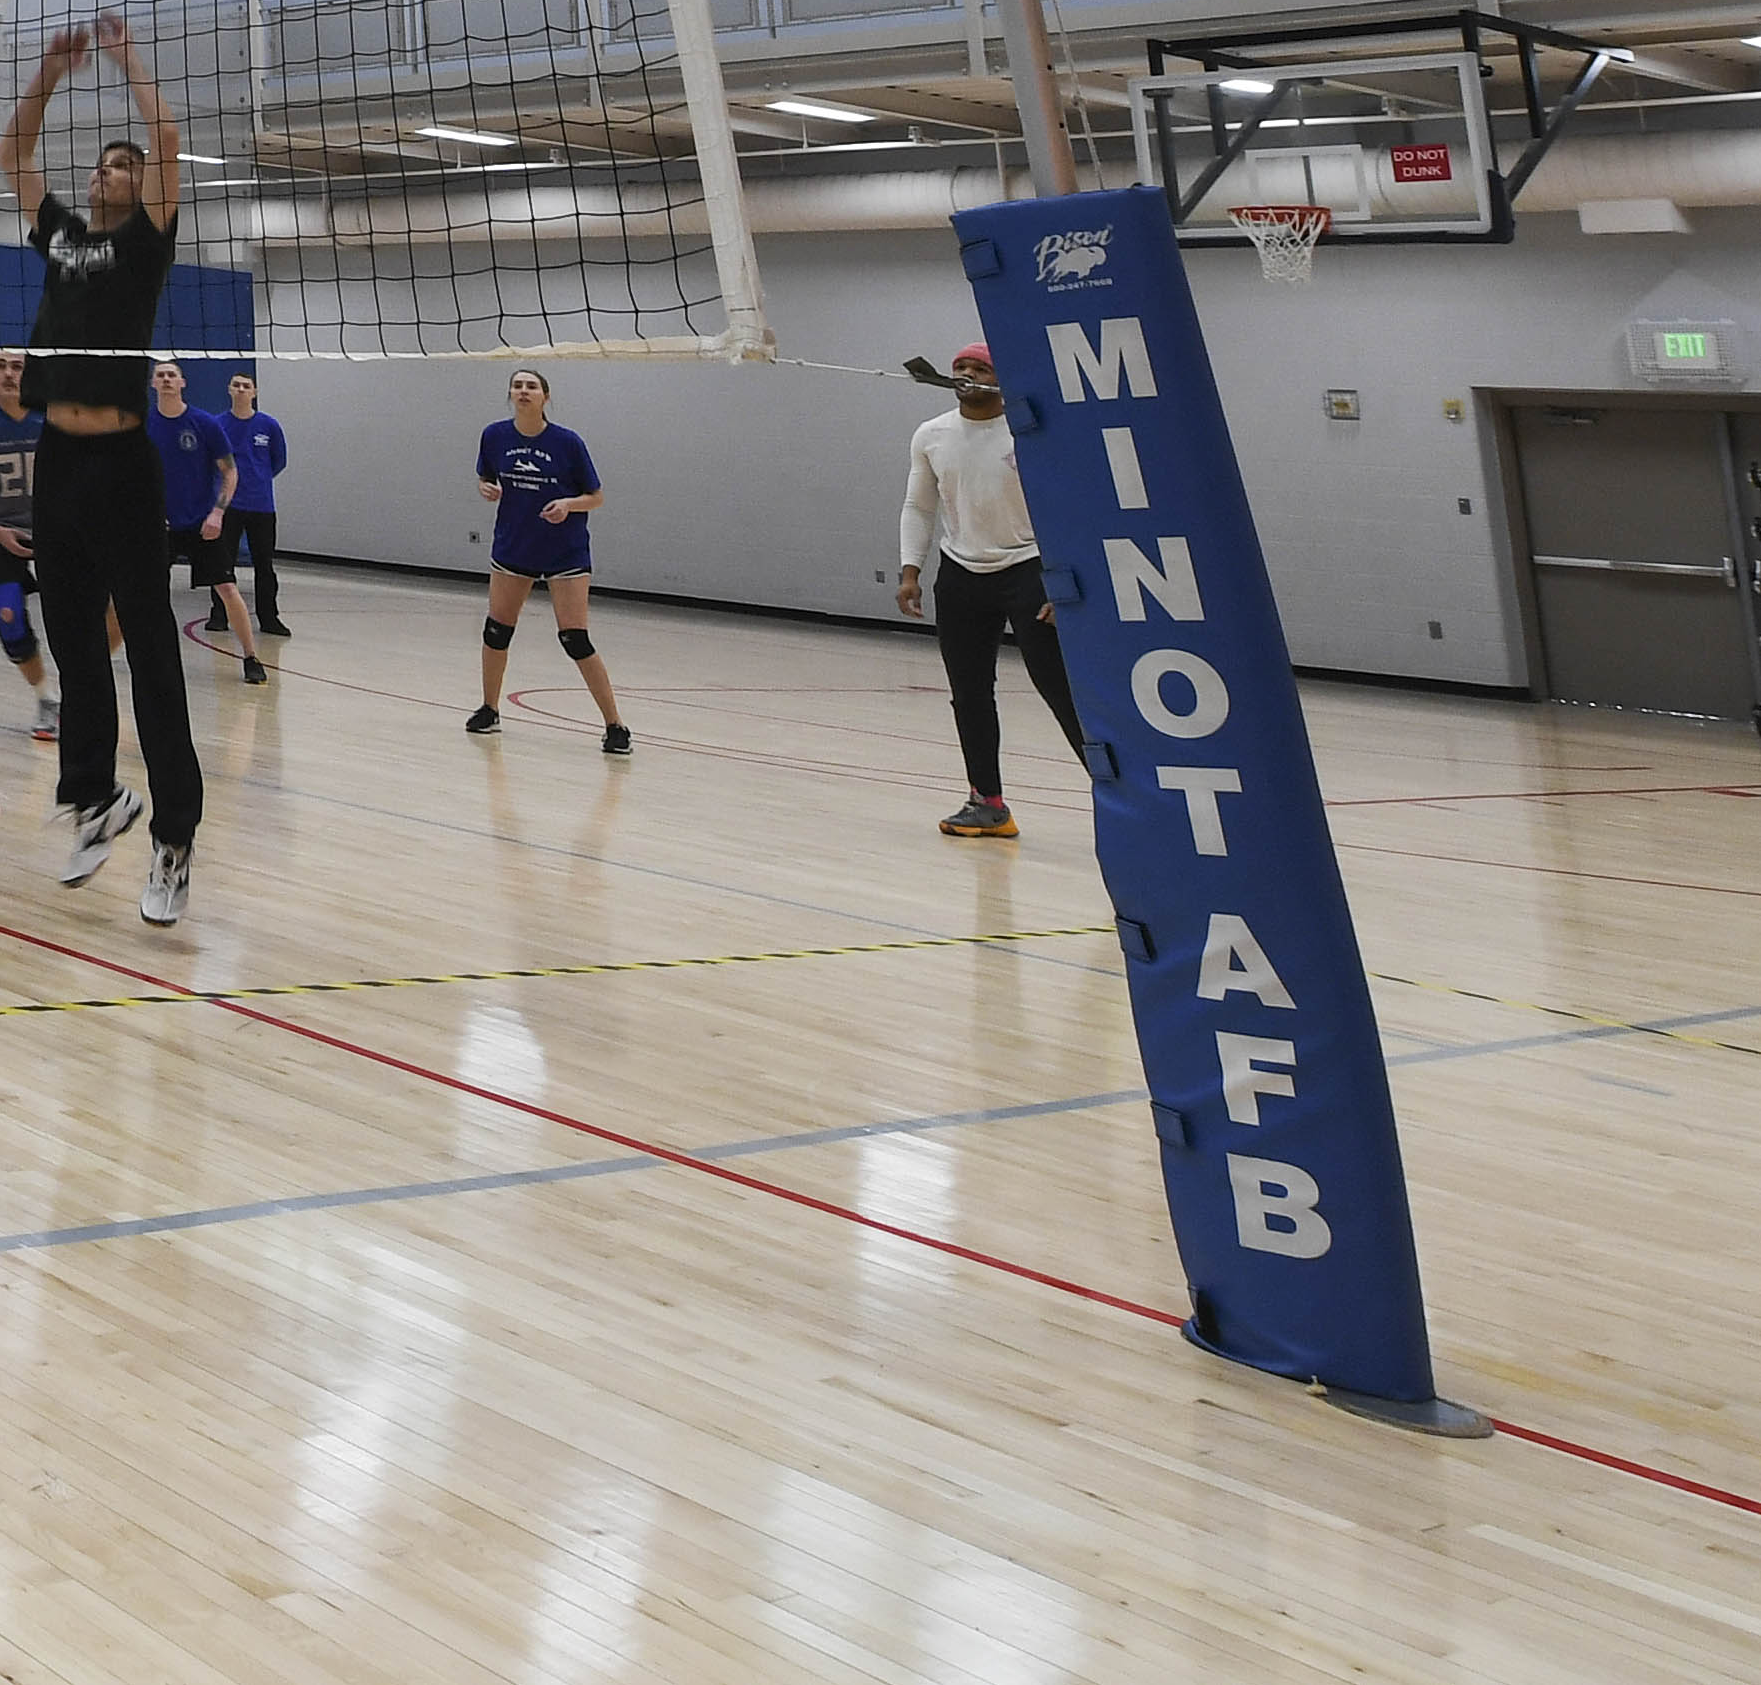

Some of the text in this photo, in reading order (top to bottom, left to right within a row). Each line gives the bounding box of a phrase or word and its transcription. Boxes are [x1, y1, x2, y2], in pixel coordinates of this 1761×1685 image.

[1393, 149, 1446, 162] DO NOT
[1402, 166, 1443, 178] DUNK
[1033, 228, 1113, 282] Bison
[1663, 333, 1705, 358] EXIT
[1045, 315, 1333, 1259] MINOT AFB
